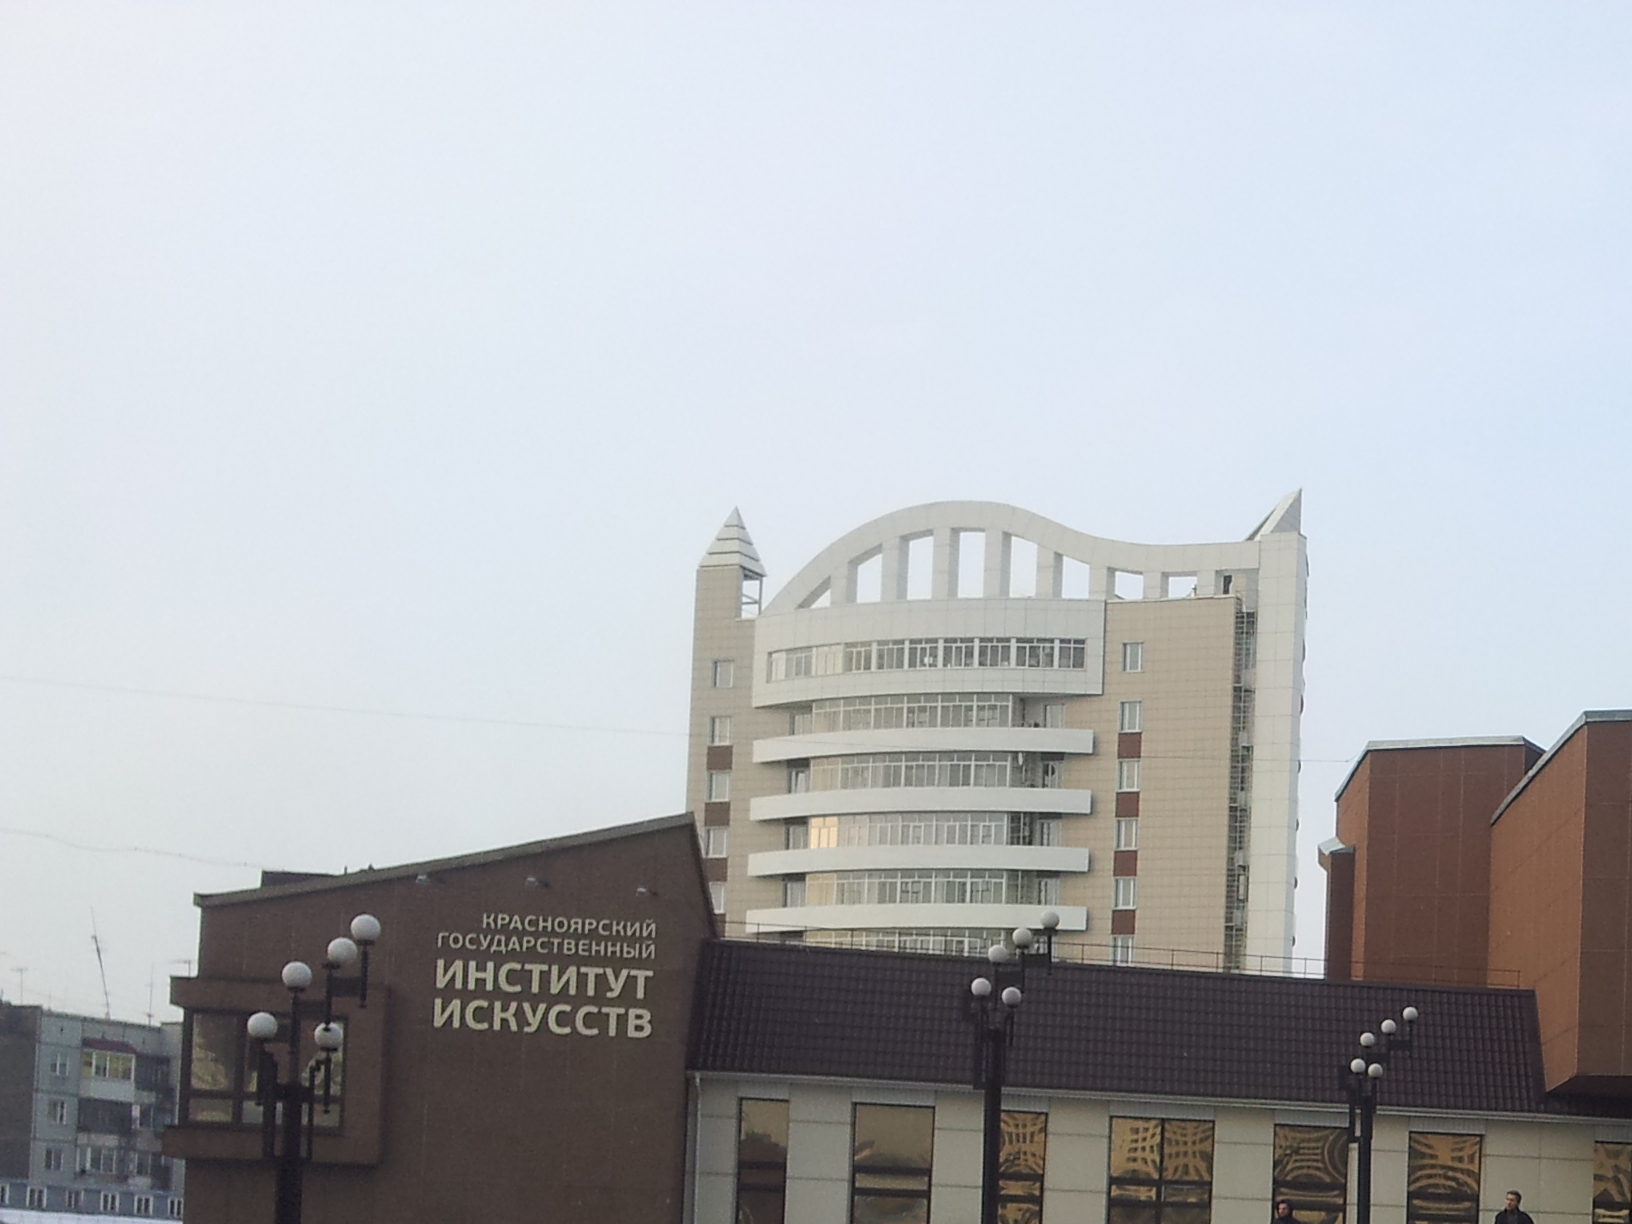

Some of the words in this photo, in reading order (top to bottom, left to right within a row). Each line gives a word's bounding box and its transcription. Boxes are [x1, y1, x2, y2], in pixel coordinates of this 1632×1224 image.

[483, 913, 656, 938] КРАСНОЯРСКИЙ
[437, 932, 656, 959] ГОСУДАРСТВЕННЫЙ
[435, 959, 654, 999] ИНСТИТУТ
[433, 998, 653, 1039] ИСКУССТВ
